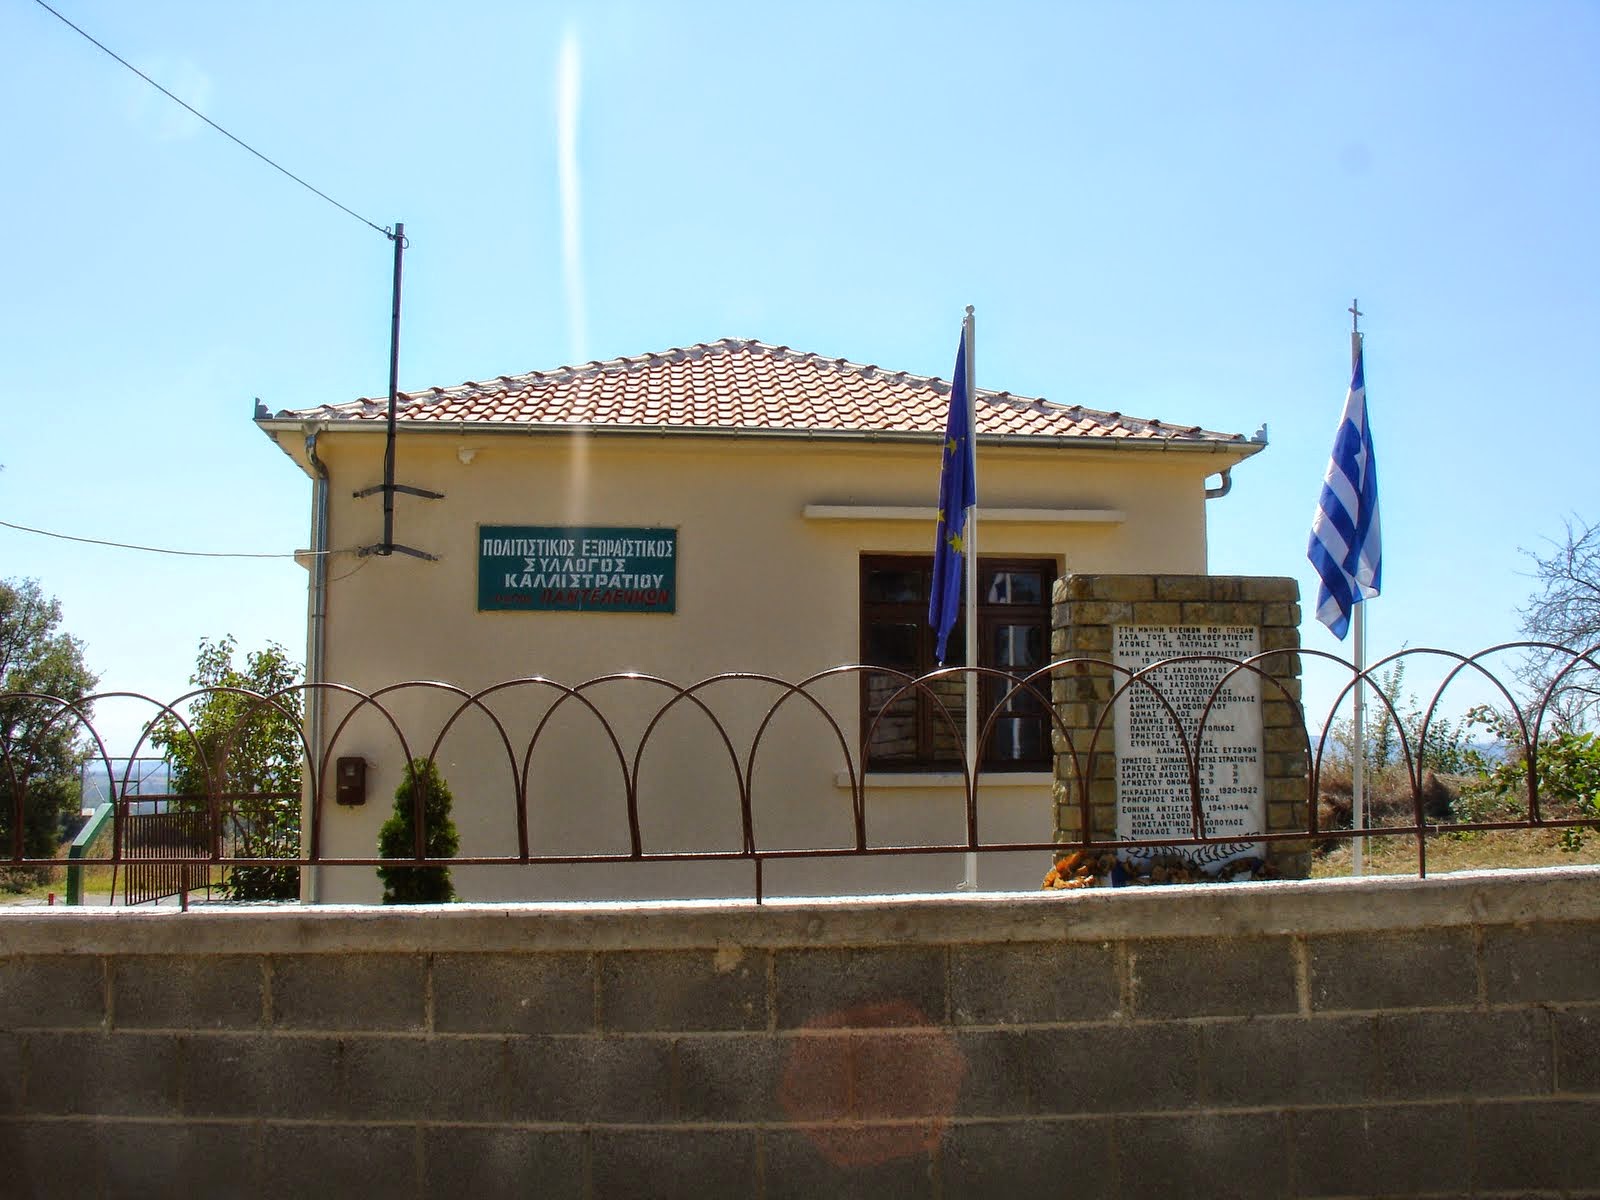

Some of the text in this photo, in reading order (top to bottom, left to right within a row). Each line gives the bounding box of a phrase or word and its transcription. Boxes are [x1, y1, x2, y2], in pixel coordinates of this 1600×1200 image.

[483, 539, 575, 556] ΠΟΛΙΤΙΣΤΙΚΟΣ
[523, 558, 626, 572] ΣΥΛΛΟΓΟΣ
[505, 574, 664, 588] ΚΑΛΛΙΣΤΡΑΤΙΟΥ
